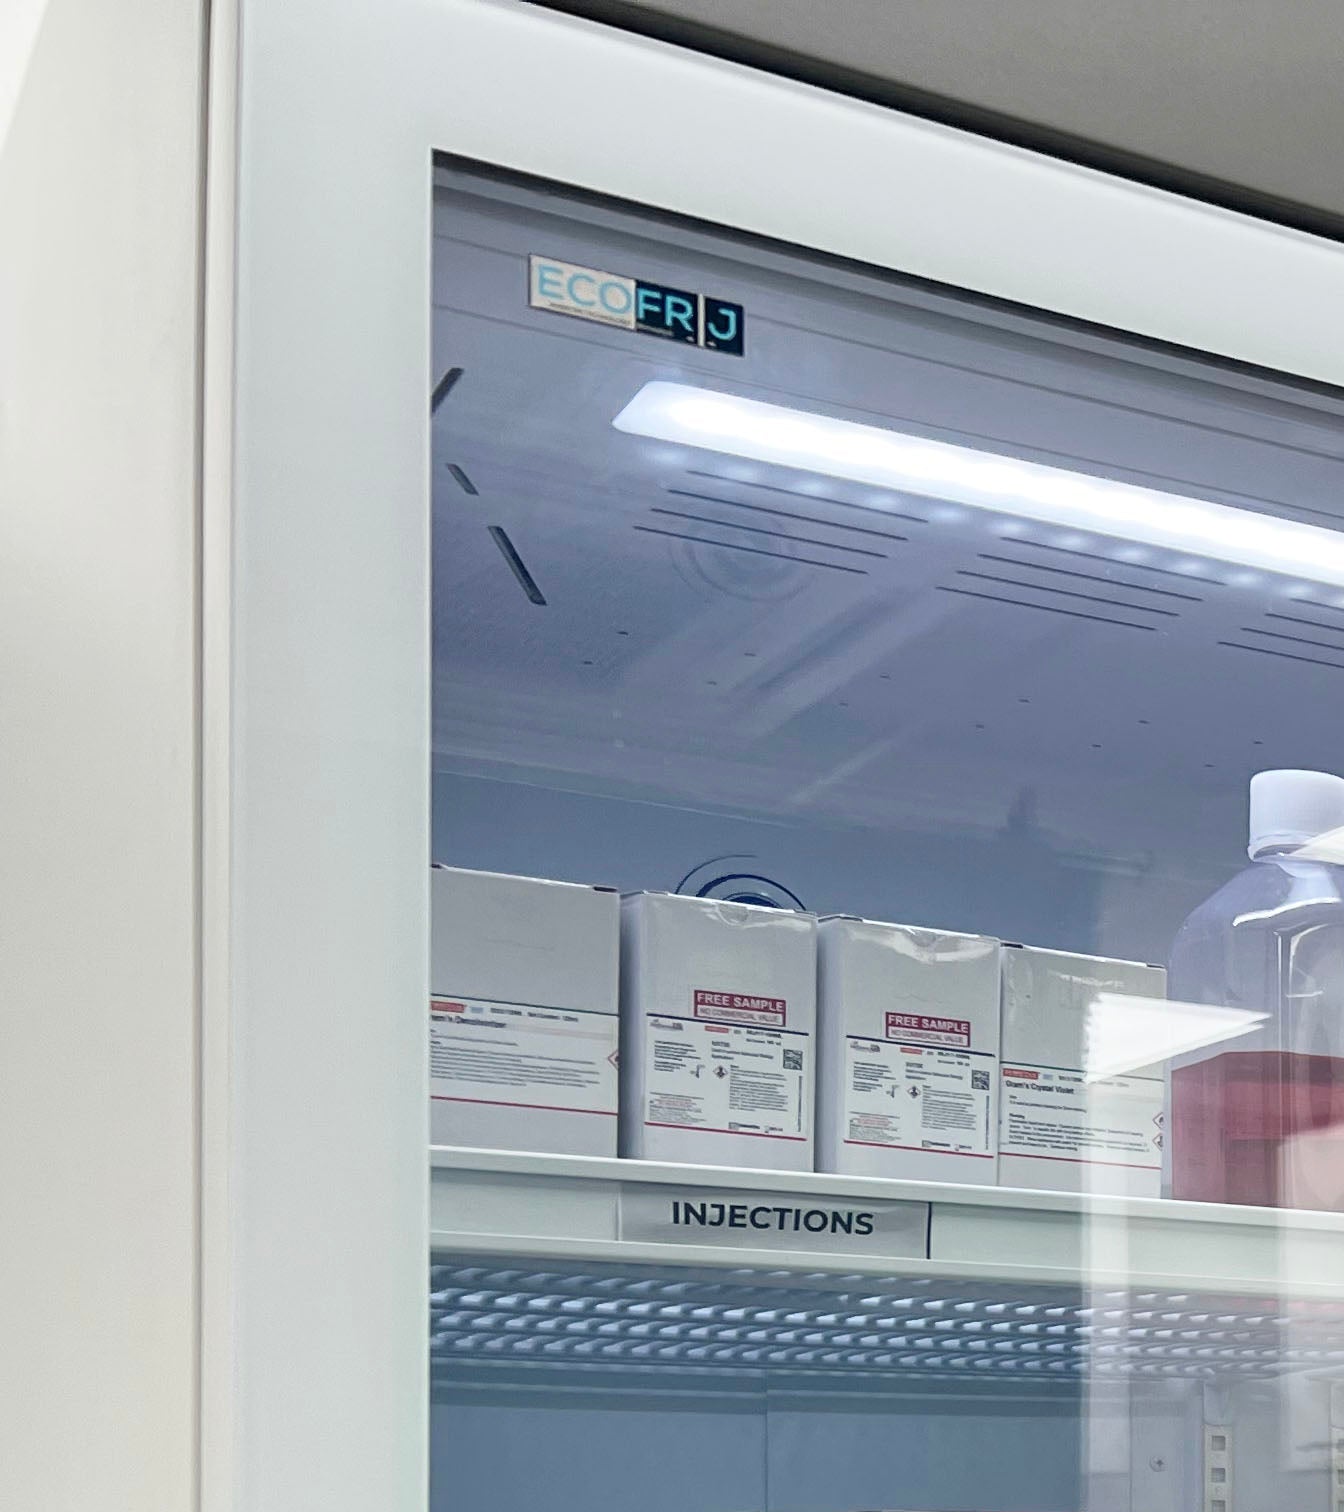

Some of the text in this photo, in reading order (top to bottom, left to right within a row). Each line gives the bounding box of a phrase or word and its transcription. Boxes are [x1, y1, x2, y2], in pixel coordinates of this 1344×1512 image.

[697, 992, 784, 1012] FREE SAMPLE
[888, 1014, 968, 1033] FREE SAMPLE
[673, 1201, 874, 1235] INJECTIONS
